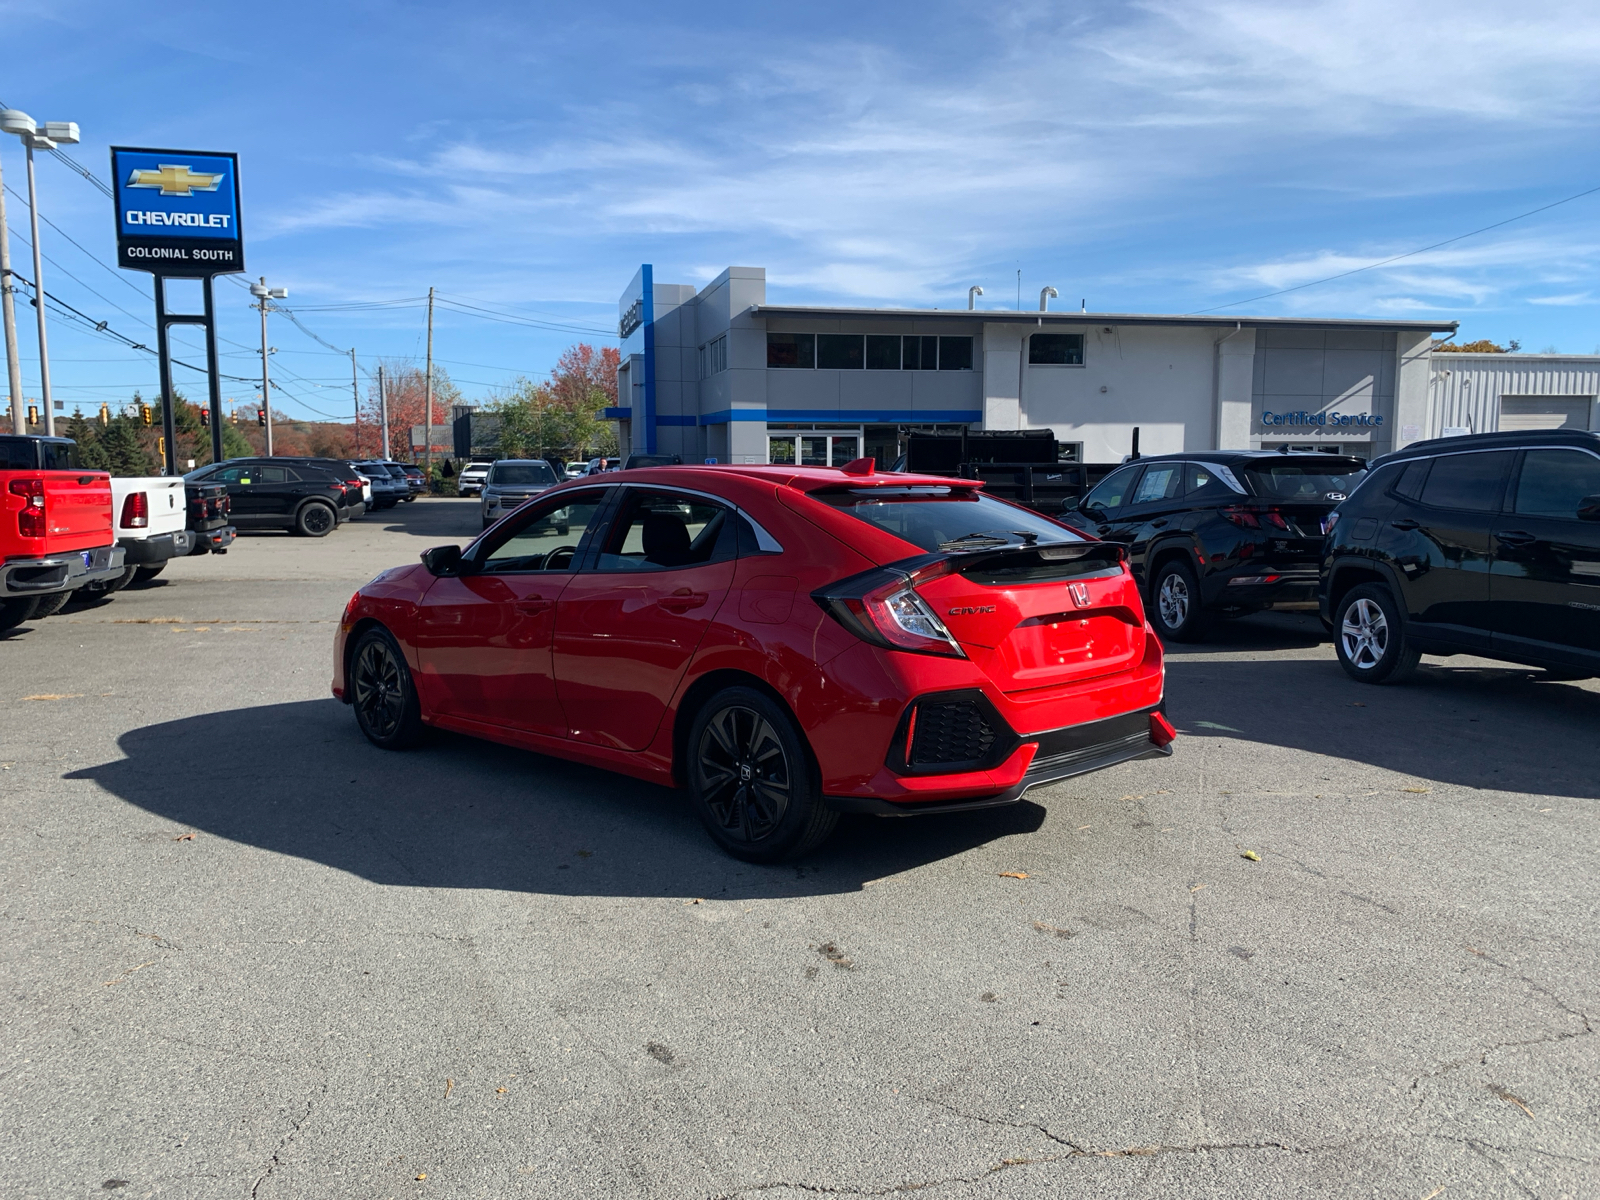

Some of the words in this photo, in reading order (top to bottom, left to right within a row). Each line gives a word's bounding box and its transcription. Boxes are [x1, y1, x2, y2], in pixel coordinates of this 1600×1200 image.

[126, 210, 231, 228] CHEVROLET
[127, 247, 189, 259] COLONIAL
[192, 249, 234, 261] SOUTH
[1262, 411, 1327, 426] Certified
[1331, 411, 1384, 426] Service
[948, 605, 996, 616] CIVIC
